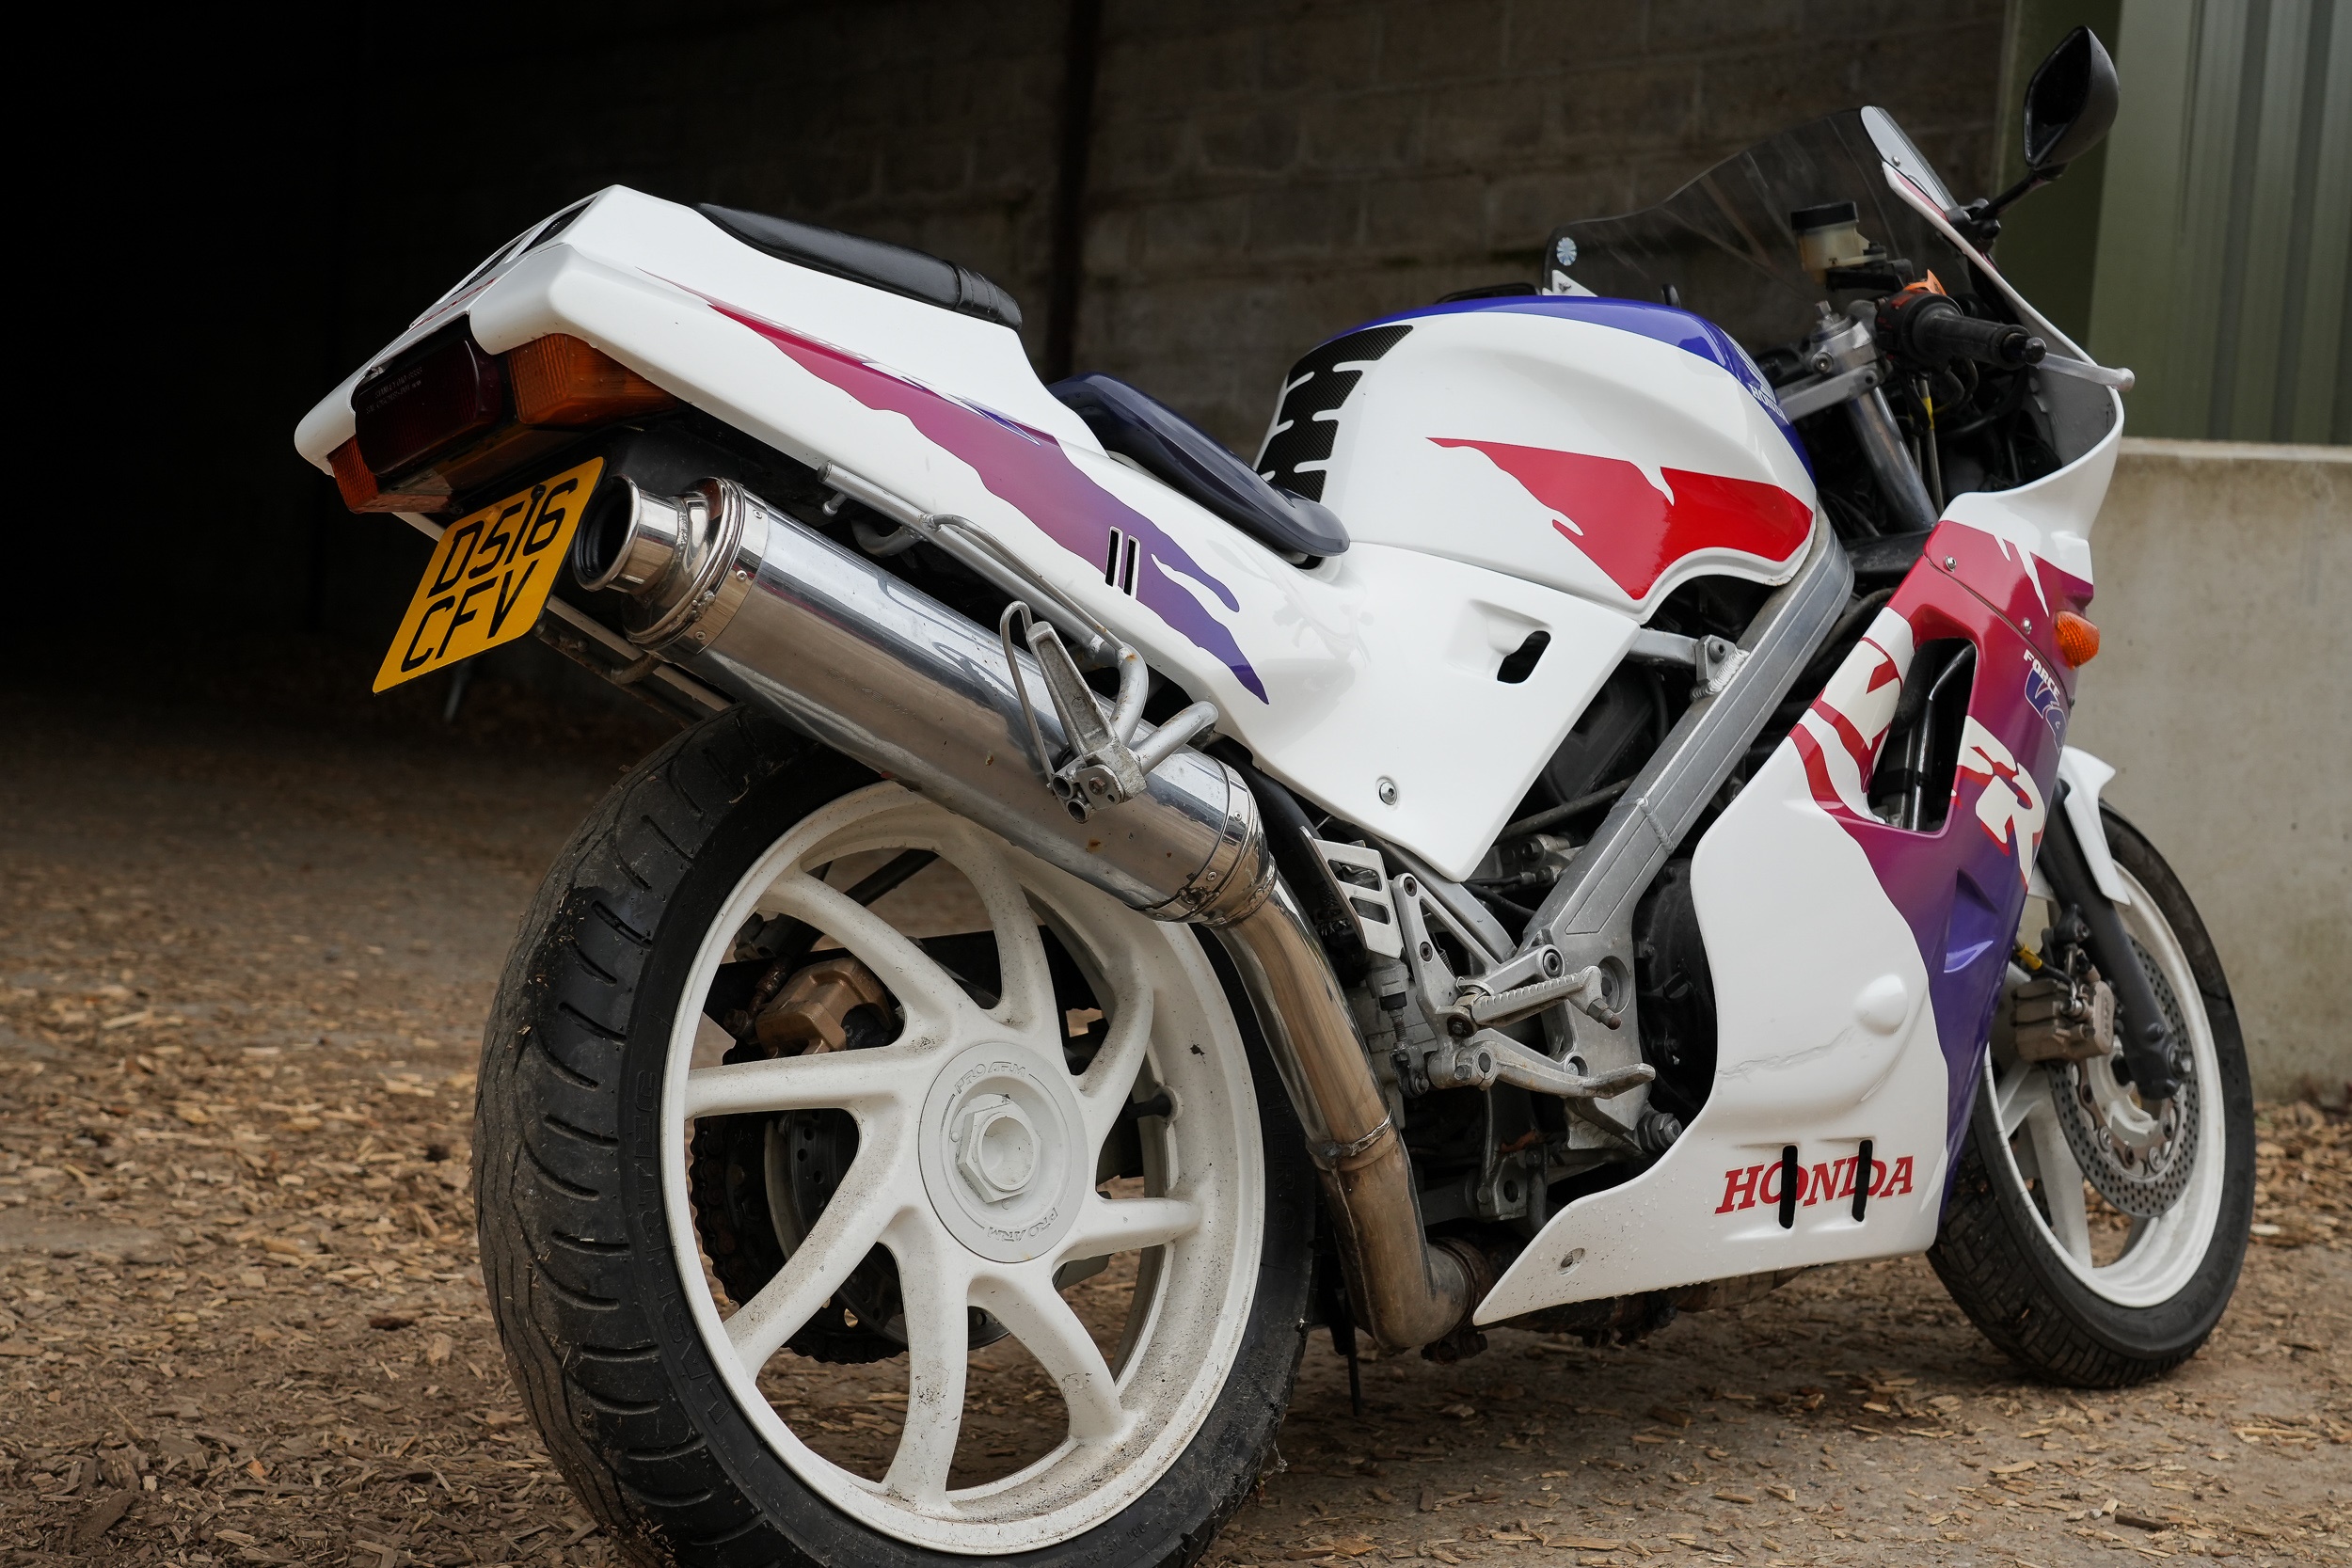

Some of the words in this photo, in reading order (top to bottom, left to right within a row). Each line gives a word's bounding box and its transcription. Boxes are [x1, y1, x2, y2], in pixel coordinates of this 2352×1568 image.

[1747, 382, 1790, 426] HONDA
[426, 477, 579, 599] D516
[400, 558, 540, 673] CFV
[2023, 649, 2060, 698] FORCE
[954, 1063, 987, 1095] PRO
[987, 1061, 1026, 1078] ARM
[1713, 1154, 1914, 1215] HONDA
[634, 1069, 731, 1425] LASERTEC
[987, 1226, 1027, 1243] ARM
[1027, 1207, 1058, 1239] PRO
